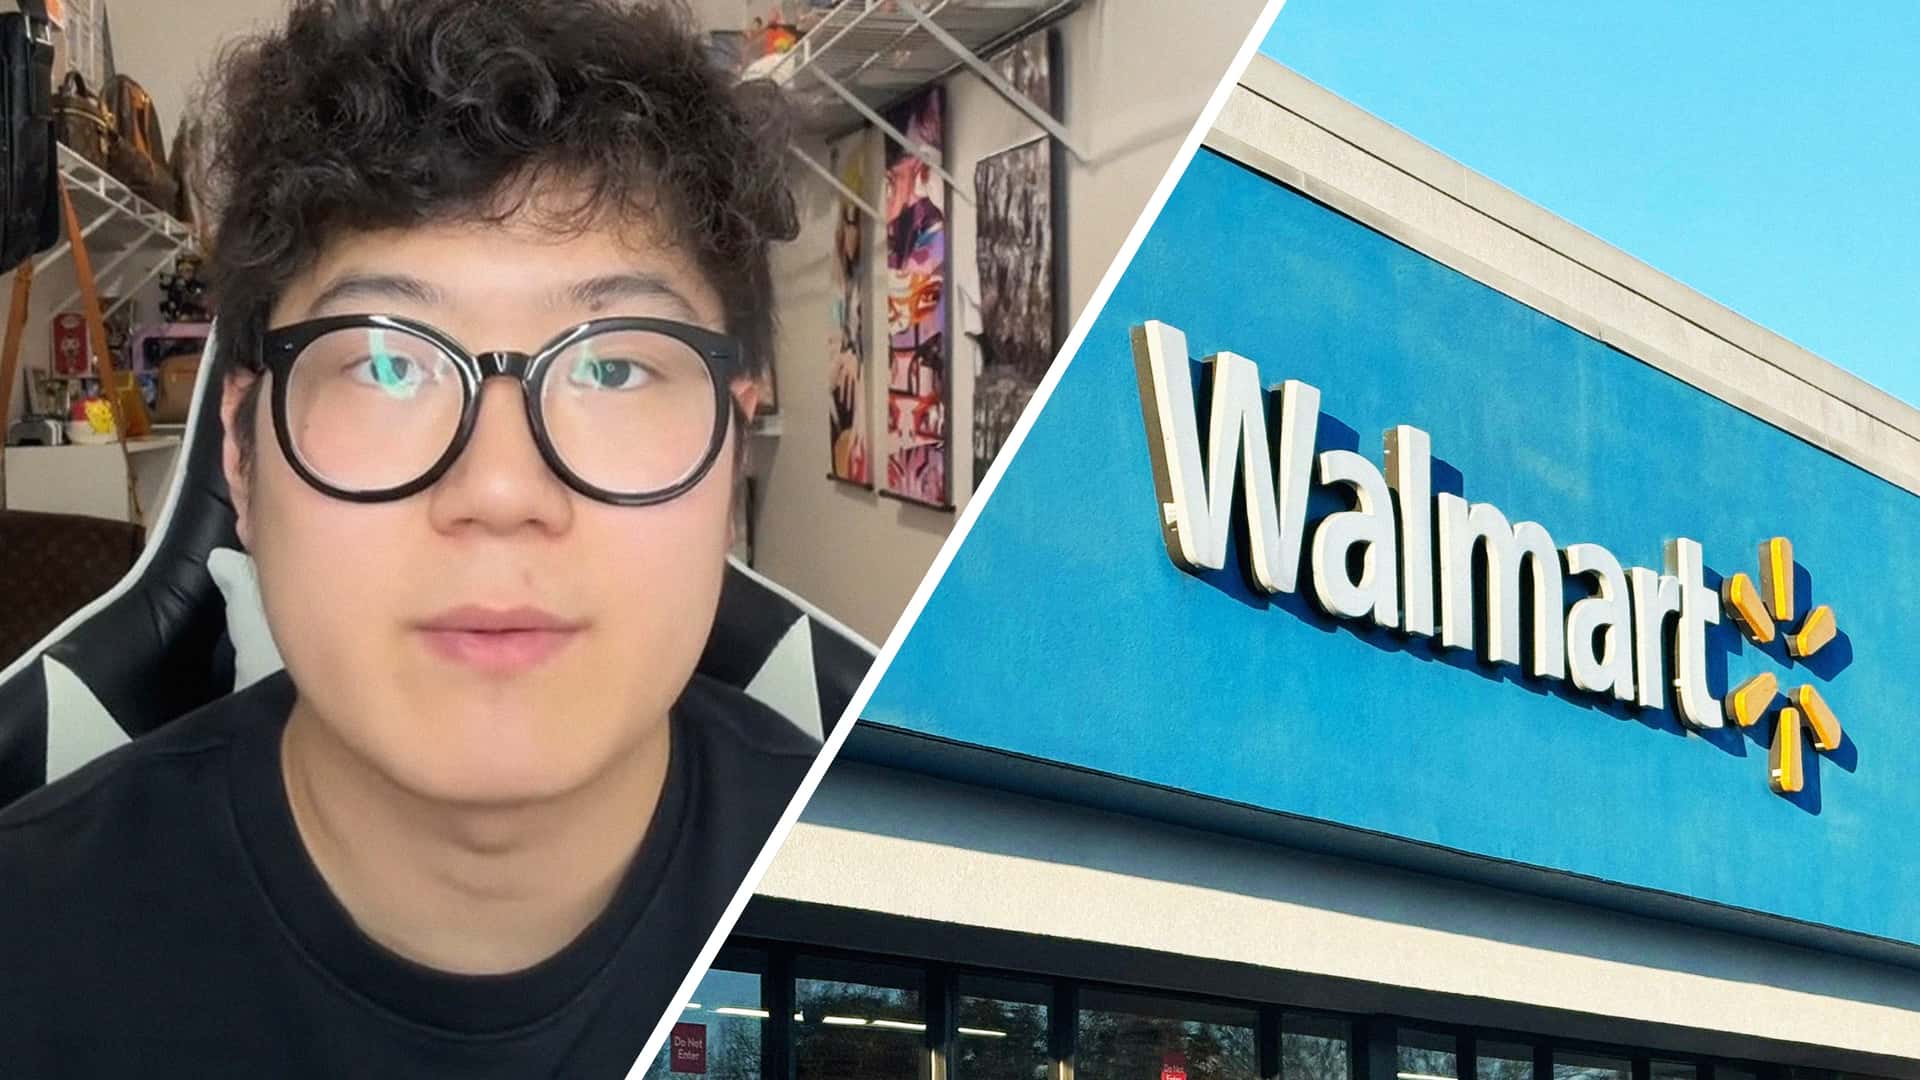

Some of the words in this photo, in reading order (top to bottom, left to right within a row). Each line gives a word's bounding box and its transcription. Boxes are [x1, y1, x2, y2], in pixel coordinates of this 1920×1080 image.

[1132, 319, 1724, 730] Walmart
[674, 1036, 686, 1047] Do
[687, 1037, 703, 1049] Not
[678, 1048, 700, 1060] Enter
